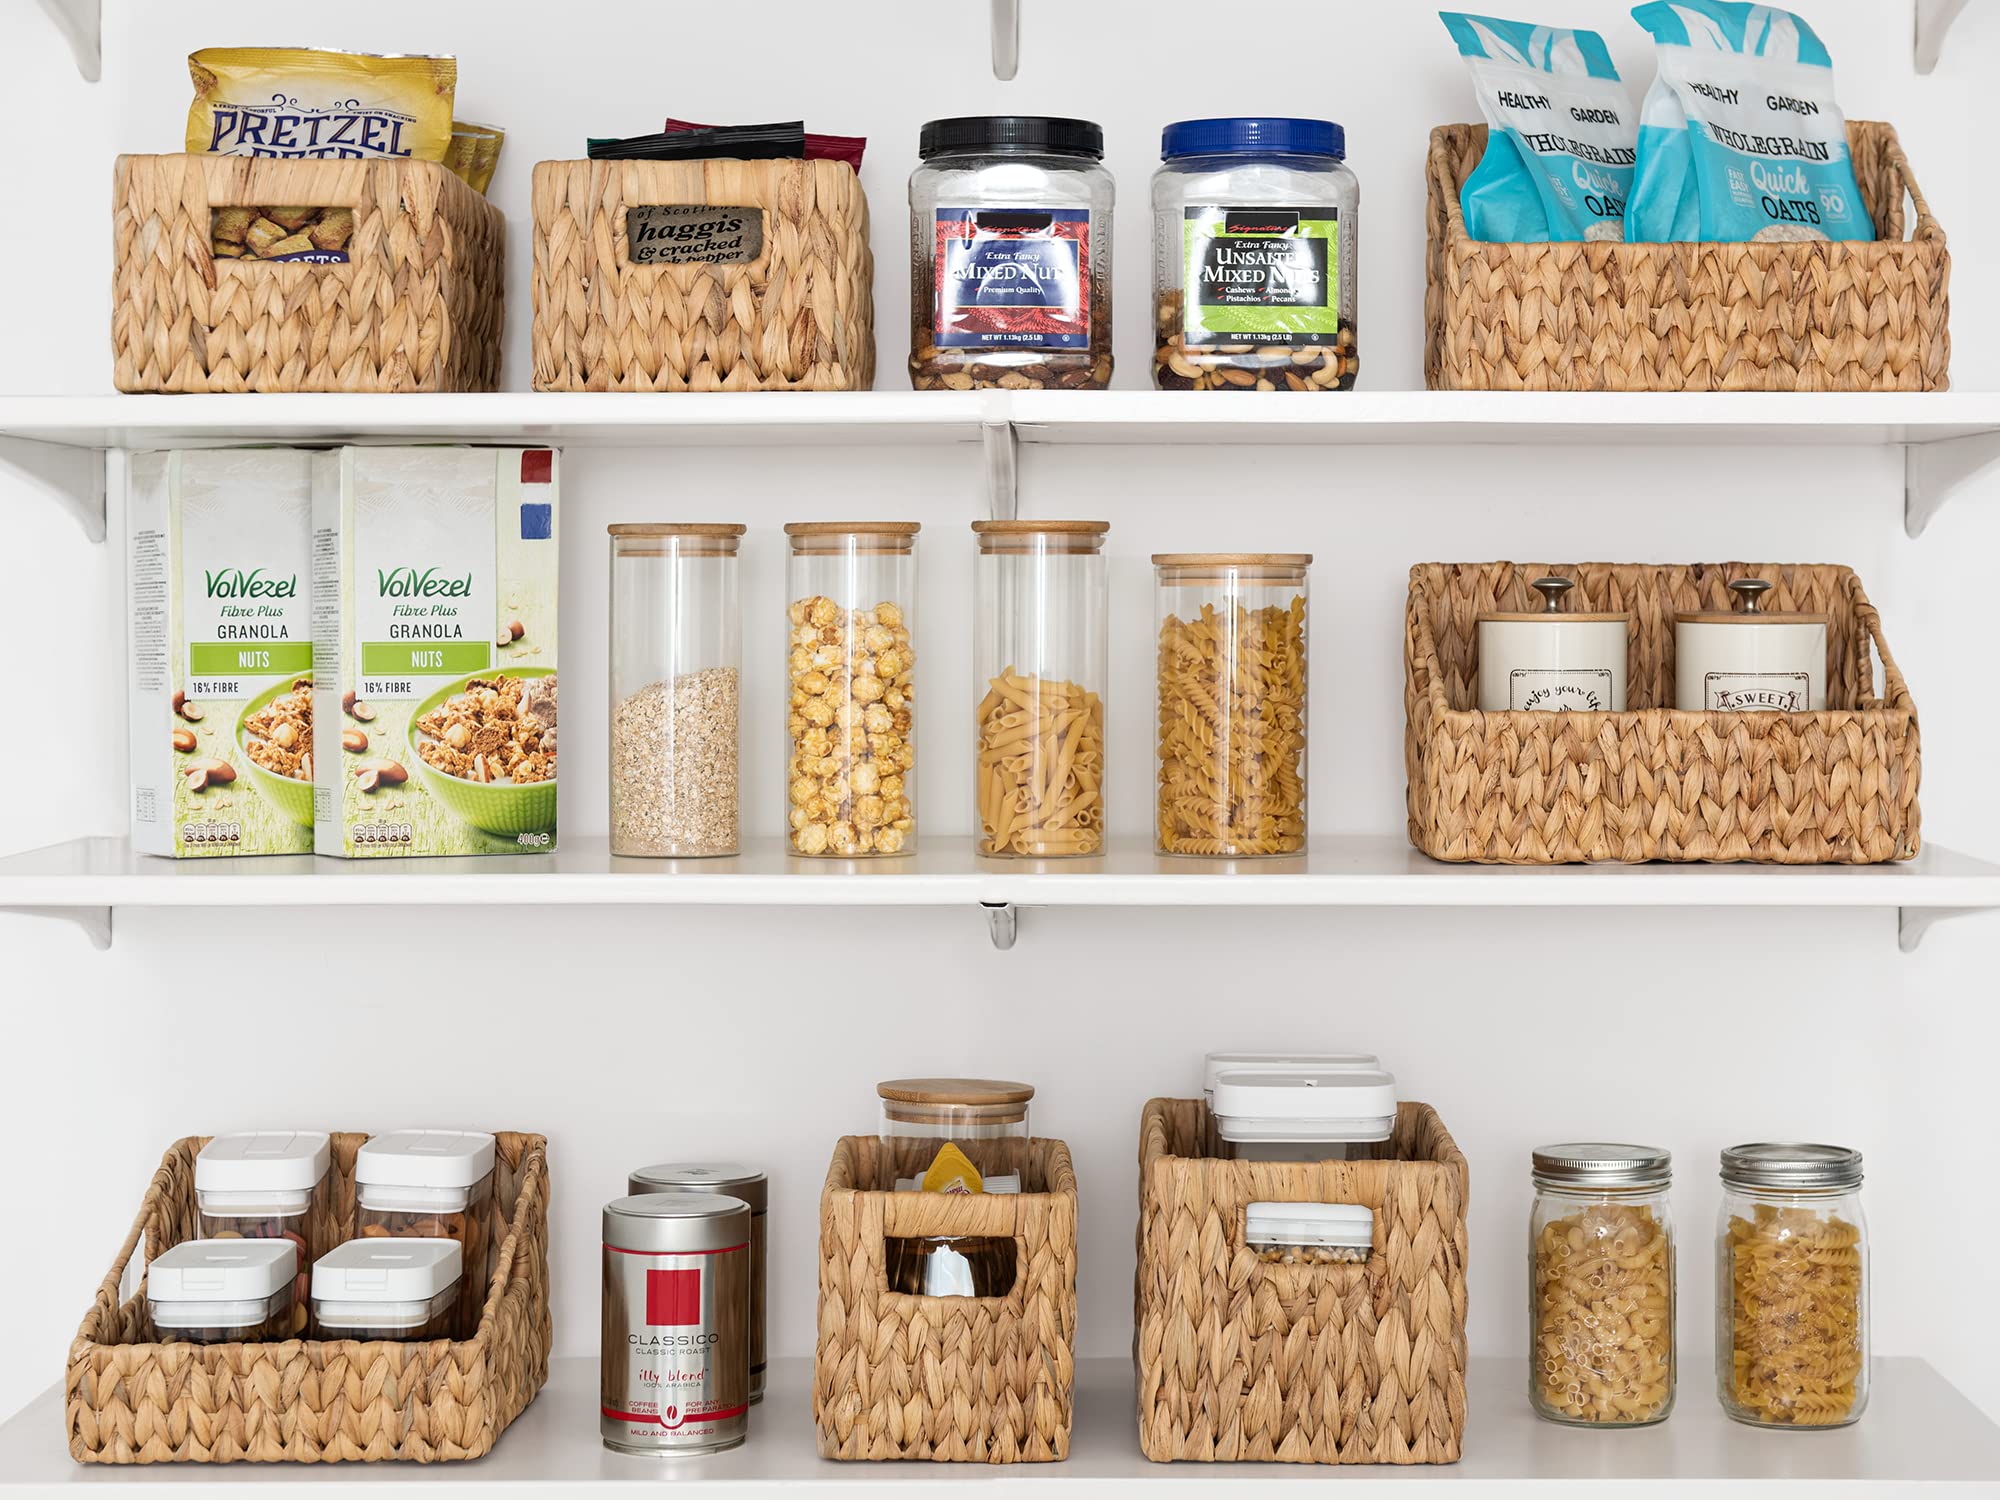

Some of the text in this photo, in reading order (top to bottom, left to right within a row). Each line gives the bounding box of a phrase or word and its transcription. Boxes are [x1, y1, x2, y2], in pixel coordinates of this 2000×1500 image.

[1688, 82, 1819, 116] HEALTHY GARDEN
[1498, 91, 1620, 125] HEALTHY GARDEN
[207, 110, 412, 157] PRETZEL
[1708, 121, 1829, 160] WHOLEGRAIN
[1572, 161, 1623, 196] Quick
[1750, 161, 1810, 200] Quick
[1761, 196, 1820, 225] OATS
[1821, 194, 1843, 213] 90
[638, 207, 656, 221] of
[636, 213, 743, 244] haggis
[637, 246, 657, 261] &
[659, 235, 743, 258] cracked
[1234, 241, 1289, 251] Extra Fancy
[985, 252, 1041, 262] Extra Fancy
[1216, 247, 1303, 265] UNSALTE
[957, 263, 1017, 280] MIXED
[1203, 266, 1266, 282] MIXED
[1016, 287, 1041, 295] Quality
[205, 568, 296, 598] VolVezel
[378, 567, 472, 597] VolVezel
[220, 605, 283, 617] Fibre Plus
[393, 604, 458, 616] Fibre Plus
[217, 625, 288, 638] GRANOLA
[390, 624, 462, 638] GRANOLA
[238, 651, 269, 668] NUTS
[411, 651, 443, 668] NUTS
[193, 682, 239, 693] 16% FIBRE
[364, 682, 411, 693] 16% FIBRE
[1524, 687, 1550, 711] enjoy
[1555, 685, 1585, 696] your
[628, 1334, 719, 1346] CLASSICO
[636, 1347, 711, 1356] CLASSIC ROAST
[639, 1369, 660, 1386] illy
[686, 1402, 736, 1413] PREPARATION
[670, 1428, 714, 1436] BALANCED
